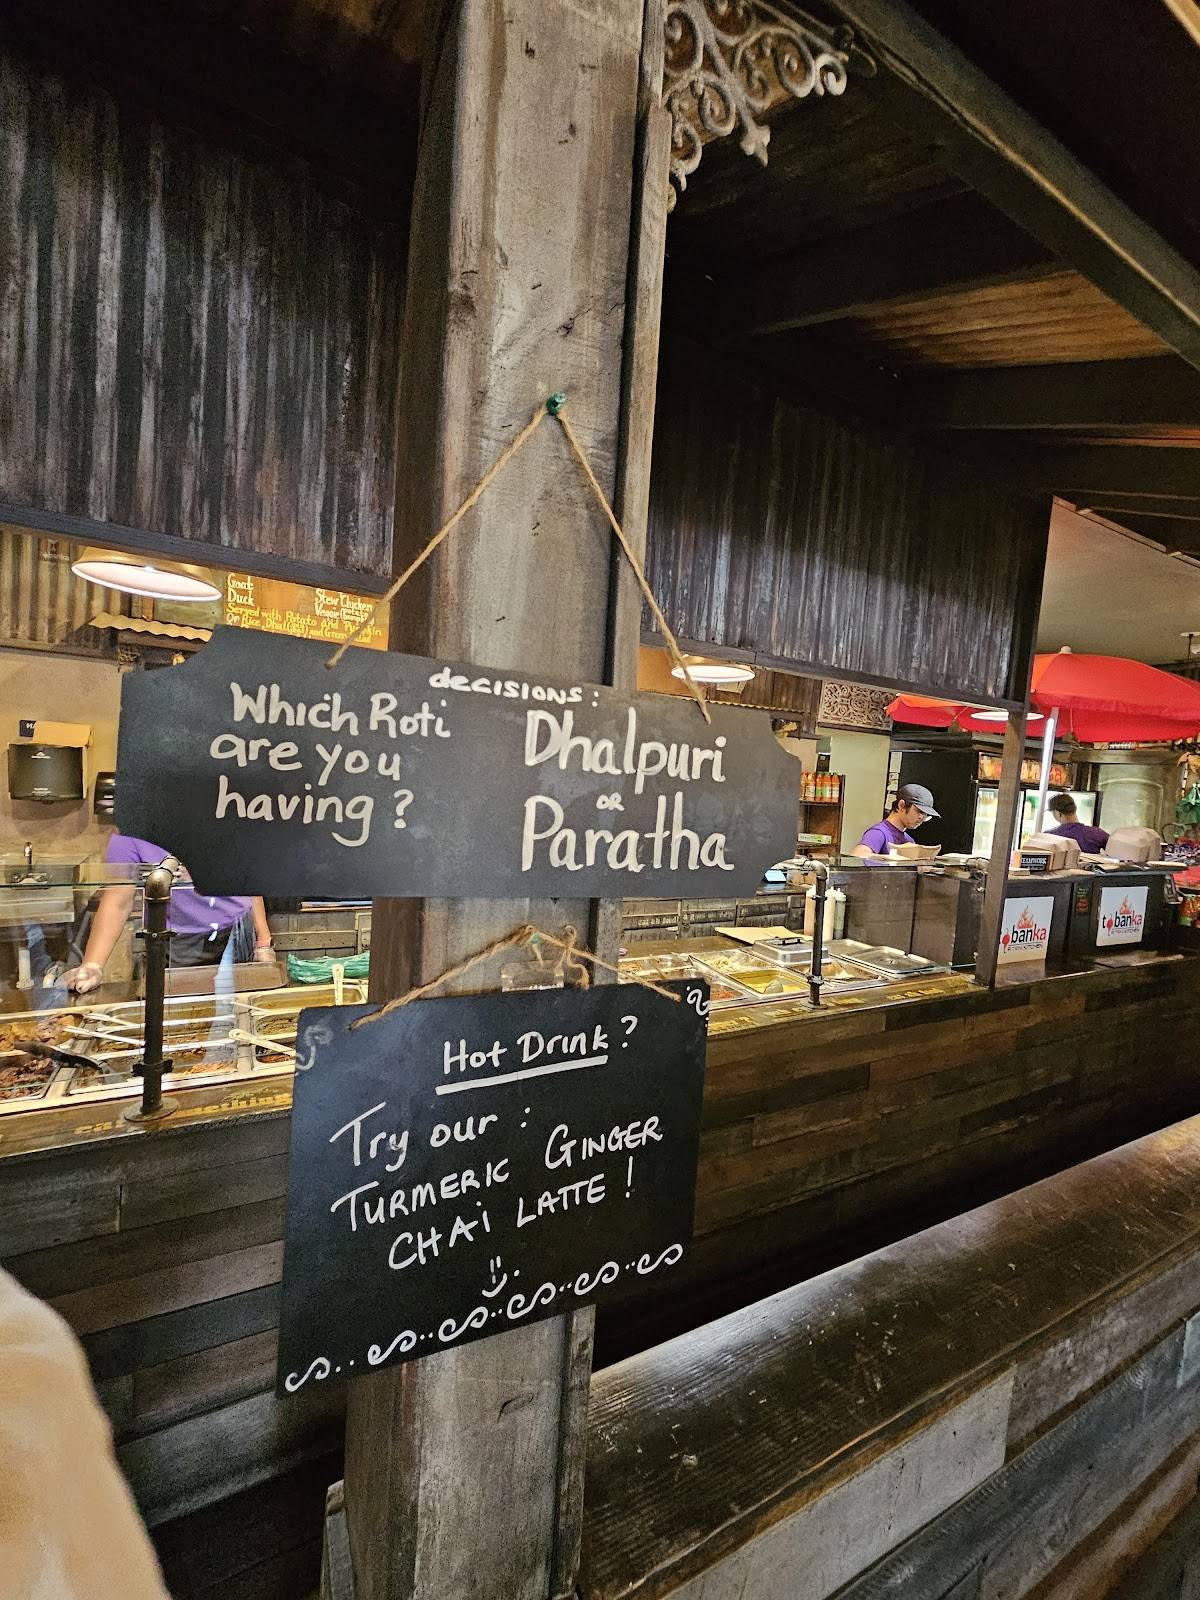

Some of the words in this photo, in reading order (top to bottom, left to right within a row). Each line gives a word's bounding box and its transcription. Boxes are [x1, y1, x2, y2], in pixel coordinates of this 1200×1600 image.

[227, 573, 254, 591] Goat
[227, 588, 255, 607] Duck
[314, 588, 339, 605] Stew
[340, 592, 373, 612] Chicken
[261, 608, 282, 621] with
[286, 611, 317, 626] Potato
[229, 682, 359, 735] Which
[369, 692, 451, 738] Roti
[210, 732, 302, 771] are
[316, 743, 400, 786] you
[523, 707, 727, 795] Dhalpuri
[214, 773, 373, 847] having
[521, 793, 736, 873] Paratha
[443, 1037, 507, 1075] Hot
[517, 1024, 609, 1063] Drink
[329, 1102, 409, 1171] Try
[430, 1114, 498, 1148] our
[331, 1158, 510, 1231] TURMERIC
[545, 1116, 663, 1170] GINGER
[517, 1174, 605, 1227] LATTE
